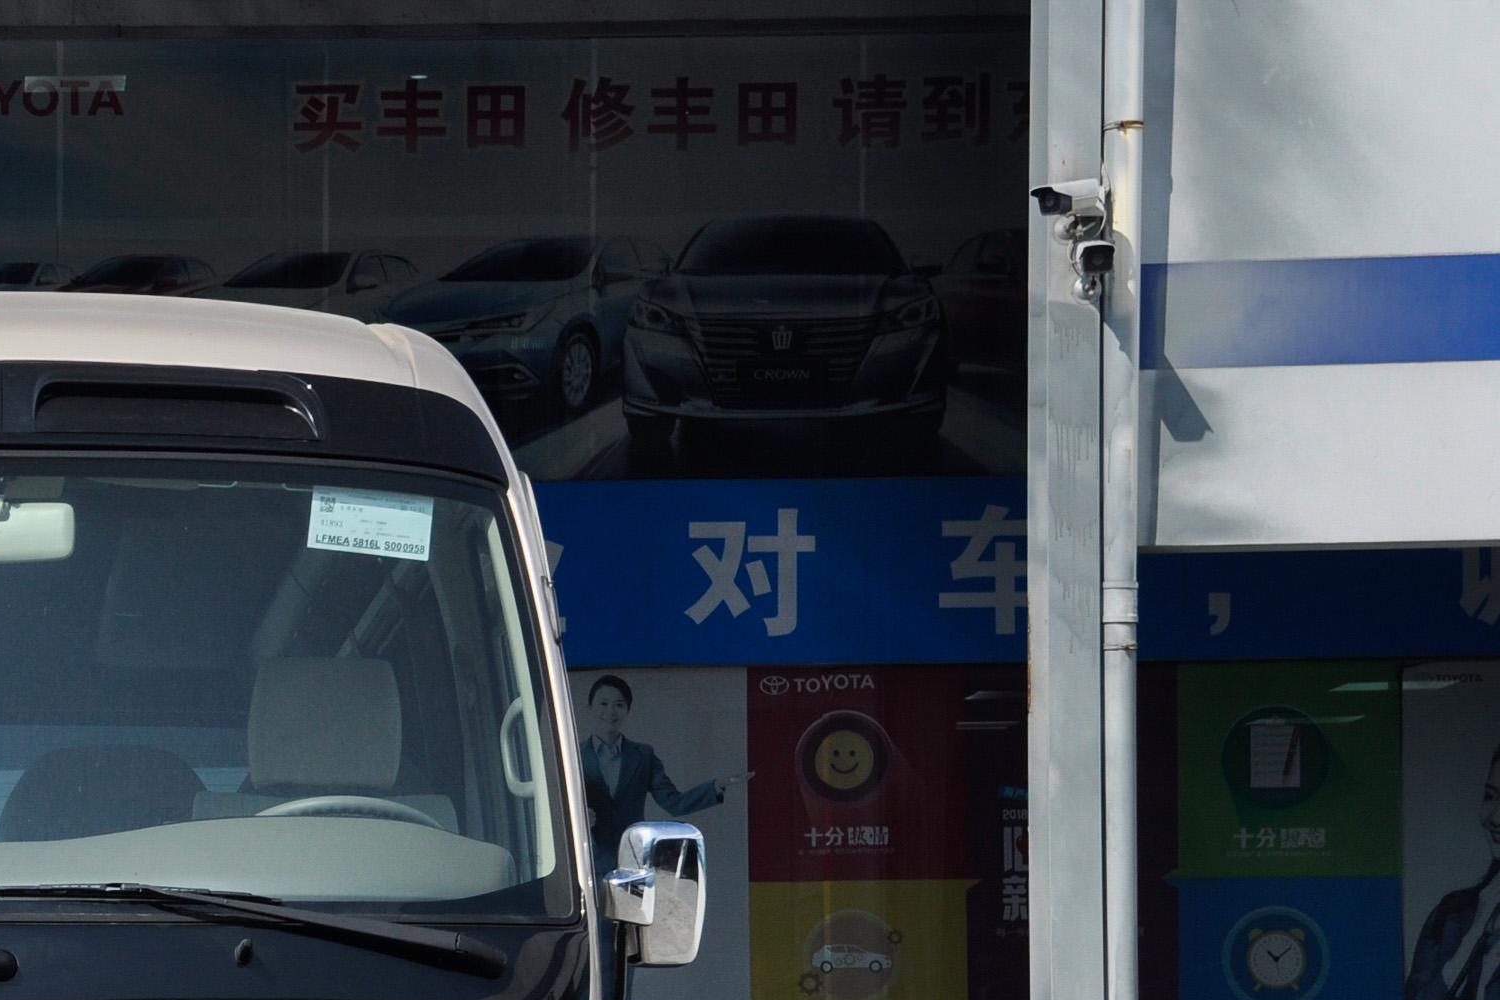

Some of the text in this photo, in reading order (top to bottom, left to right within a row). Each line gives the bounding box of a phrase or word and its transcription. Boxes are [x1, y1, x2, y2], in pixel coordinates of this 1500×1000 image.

[292, 72, 1029, 154] 买丰田 修丰田 请到
[754, 367, 810, 380] CROWN
[315, 533, 350, 546] LFMEA
[794, 674, 875, 694] TOYOTA
